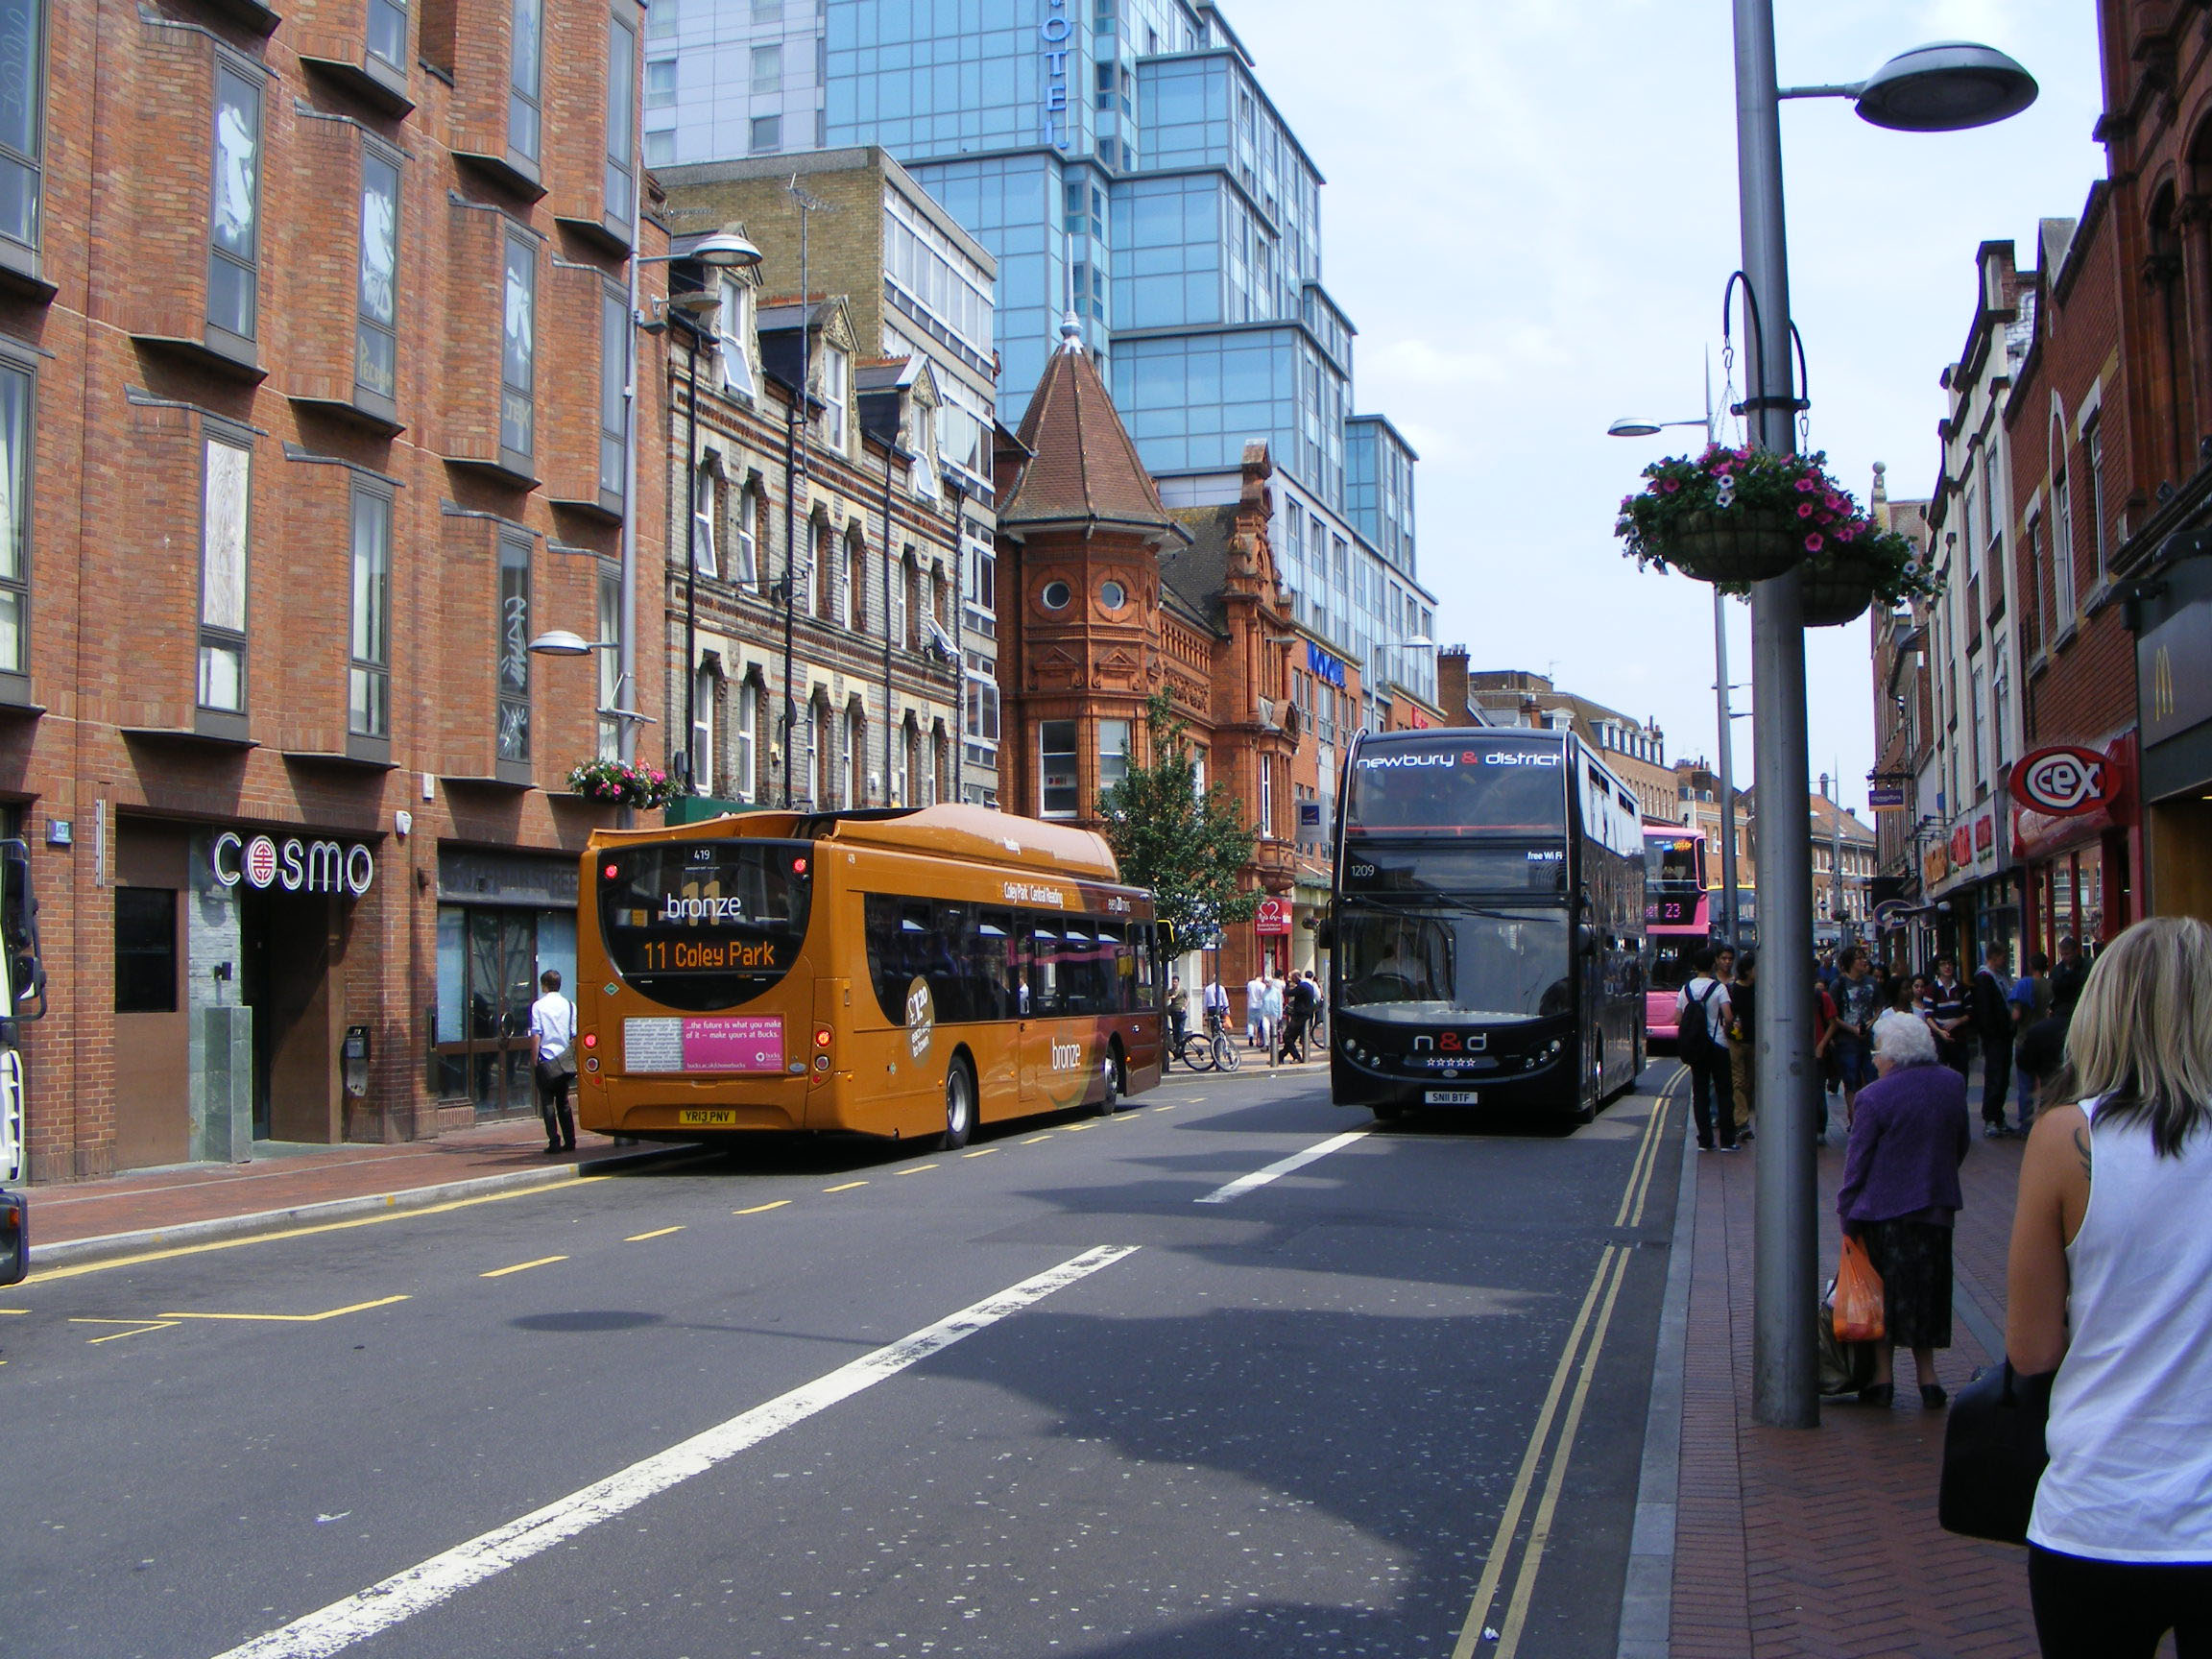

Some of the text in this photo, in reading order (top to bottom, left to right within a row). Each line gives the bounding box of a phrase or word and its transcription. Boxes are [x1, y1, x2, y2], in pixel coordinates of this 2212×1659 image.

[1042, 0, 1071, 150] OTEL
[1356, 751, 1561, 769] newbury & district
[693, 849, 710, 860] 419
[1527, 851, 1563, 860] free Wi Fi
[212, 830, 374, 897] COSMO
[1351, 864, 1375, 878] 1209
[666, 892, 742, 919] bronze
[1665, 902, 1681, 918] 23
[644, 940, 775, 969] 11 Coley Park
[704, 1020, 722, 1029] future
[725, 1021, 731, 1029] is
[733, 1020, 748, 1029] what
[750, 1021, 763, 1031] you
[764, 1020, 781, 1028] make
[685, 1030, 693, 1039] of
[695, 1030, 700, 1039] it
[709, 1030, 726, 1039] make
[729, 1031, 746, 1041] yours
[749, 1030, 756, 1039] at
[1414, 1032, 1487, 1051] n & d
[1051, 1036, 1081, 1070] bronze
[1452, 1093, 1470, 1102] BTF
[685, 1111, 730, 1122] YR13 PNV
